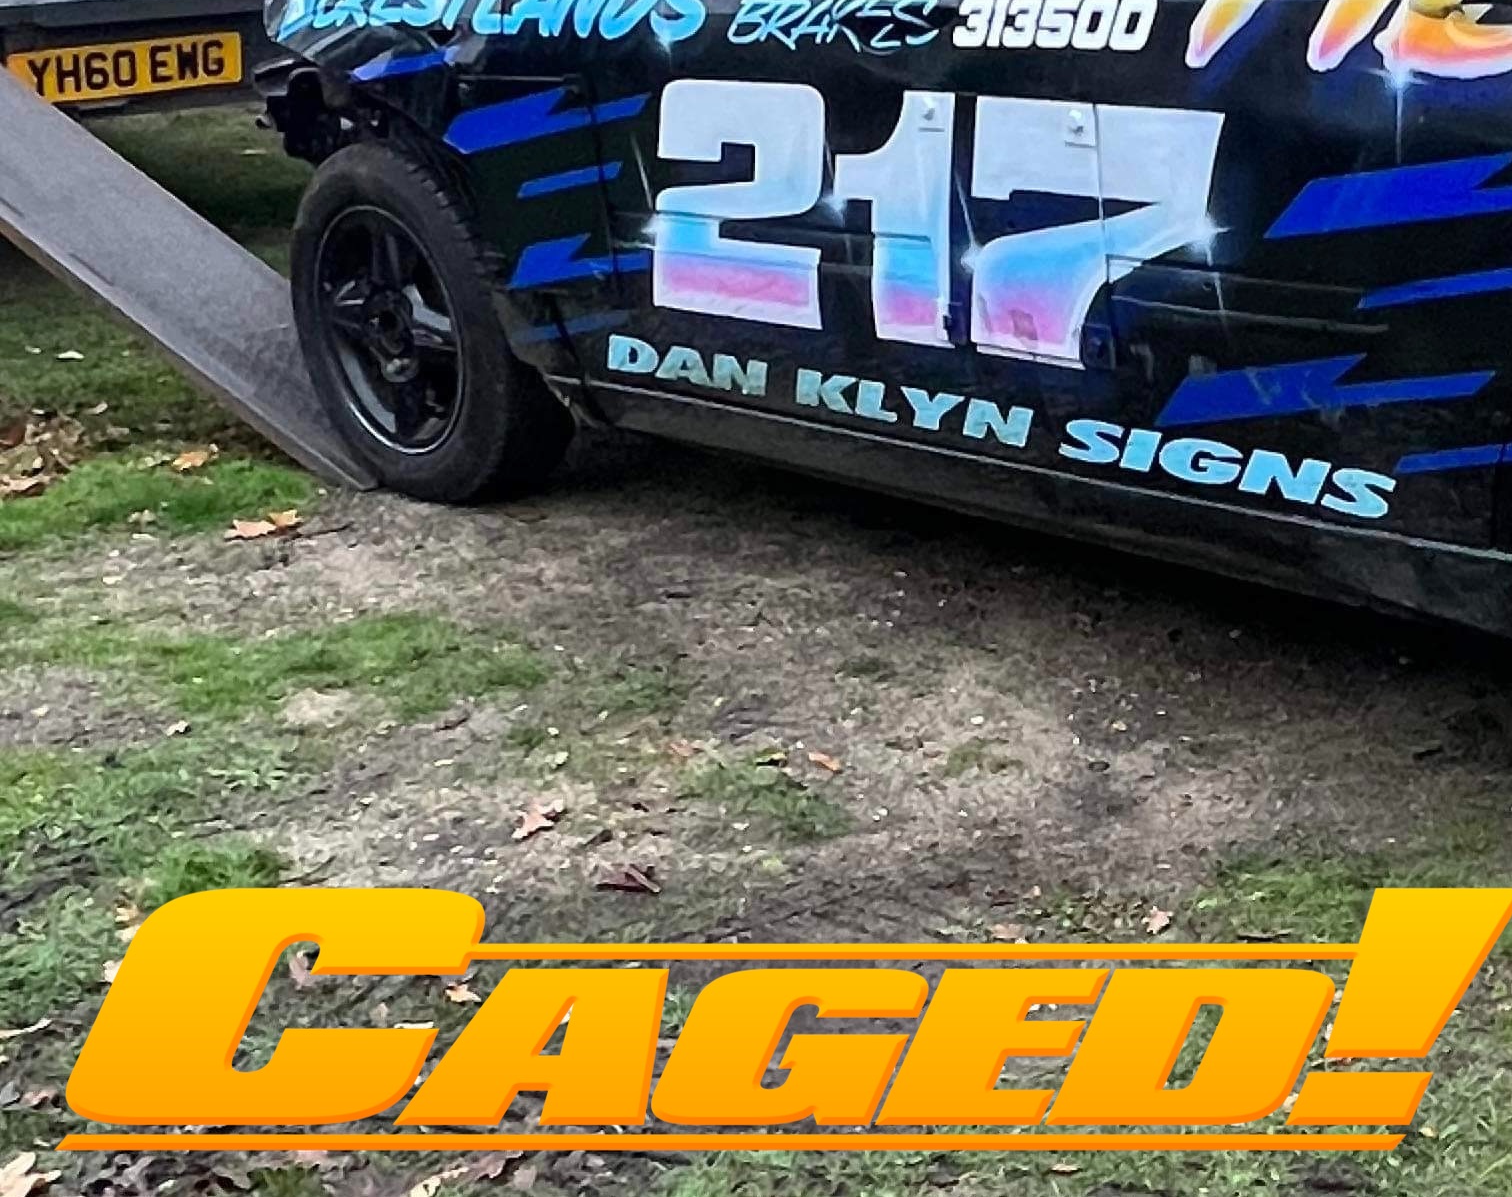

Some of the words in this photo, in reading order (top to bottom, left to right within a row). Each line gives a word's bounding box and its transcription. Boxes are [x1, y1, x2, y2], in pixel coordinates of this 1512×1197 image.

[26, 49, 138, 97] YH60
[149, 39, 225, 84] EWG
[652, 78, 1226, 370] 217
[606, 334, 768, 396] DAN
[795, 369, 1034, 448] KLYN
[1058, 418, 1398, 520] SIGNS
